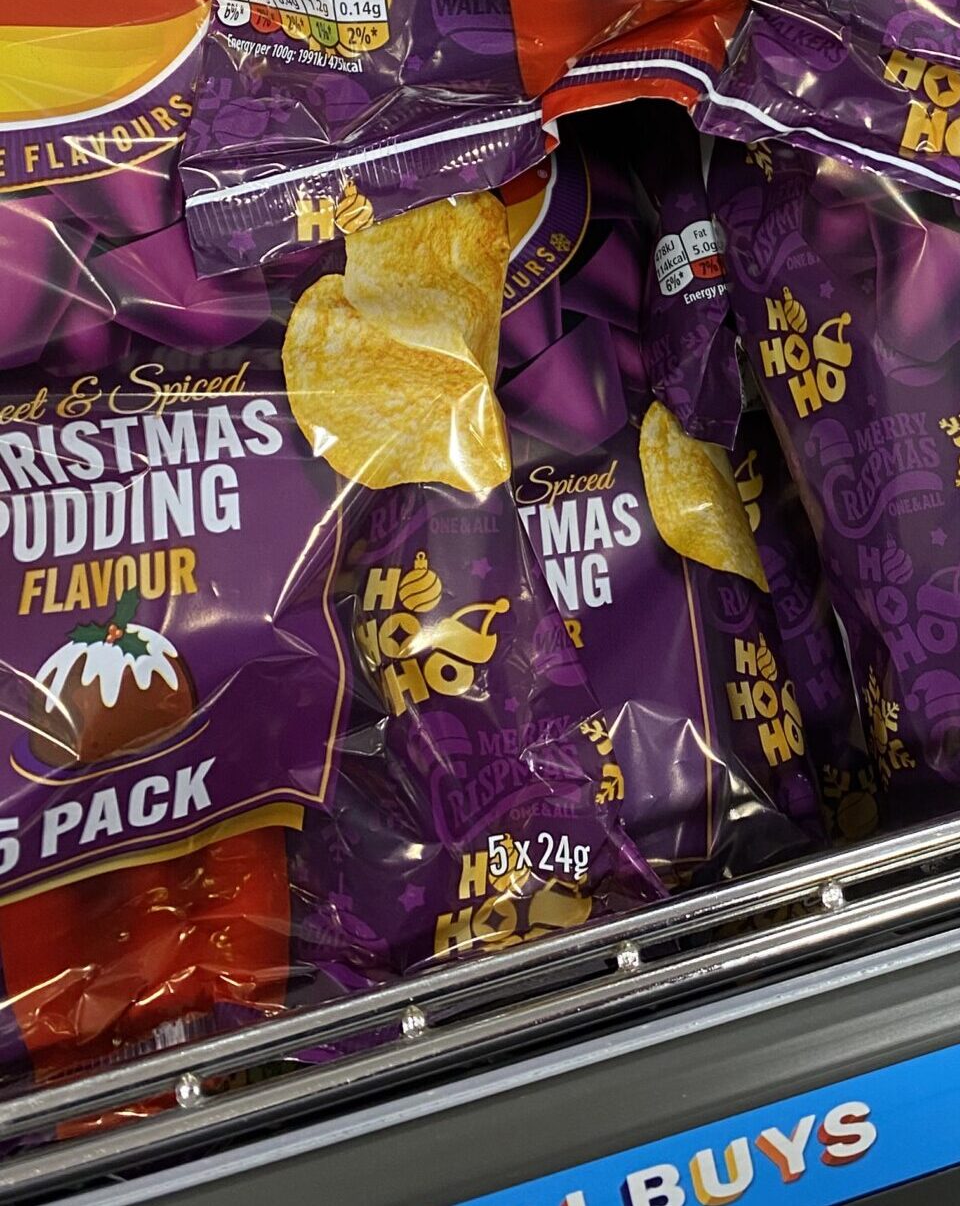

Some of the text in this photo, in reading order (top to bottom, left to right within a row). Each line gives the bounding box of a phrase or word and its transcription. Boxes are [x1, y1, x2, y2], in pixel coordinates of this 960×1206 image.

[339, 1, 381, 18] 0.14g
[227, 34, 256, 55] Energy
[256, 43, 271, 58] per
[26, 93, 194, 174] FLAVOURS
[693, 228, 707, 240] Fat
[683, 285, 717, 305] Energy
[759, 334, 811, 379] HO
[57, 376, 102, 418] &
[110, 361, 251, 420] Spiced
[788, 360, 847, 419] HO
[0, 398, 284, 492] RISTMAS
[515, 460, 618, 508] Spiced
[18, 548, 198, 616] FLAVOUR
[364, 551, 443, 615] HO
[41, 756, 217, 859] PACK
[537, 832, 592, 880] 24g
